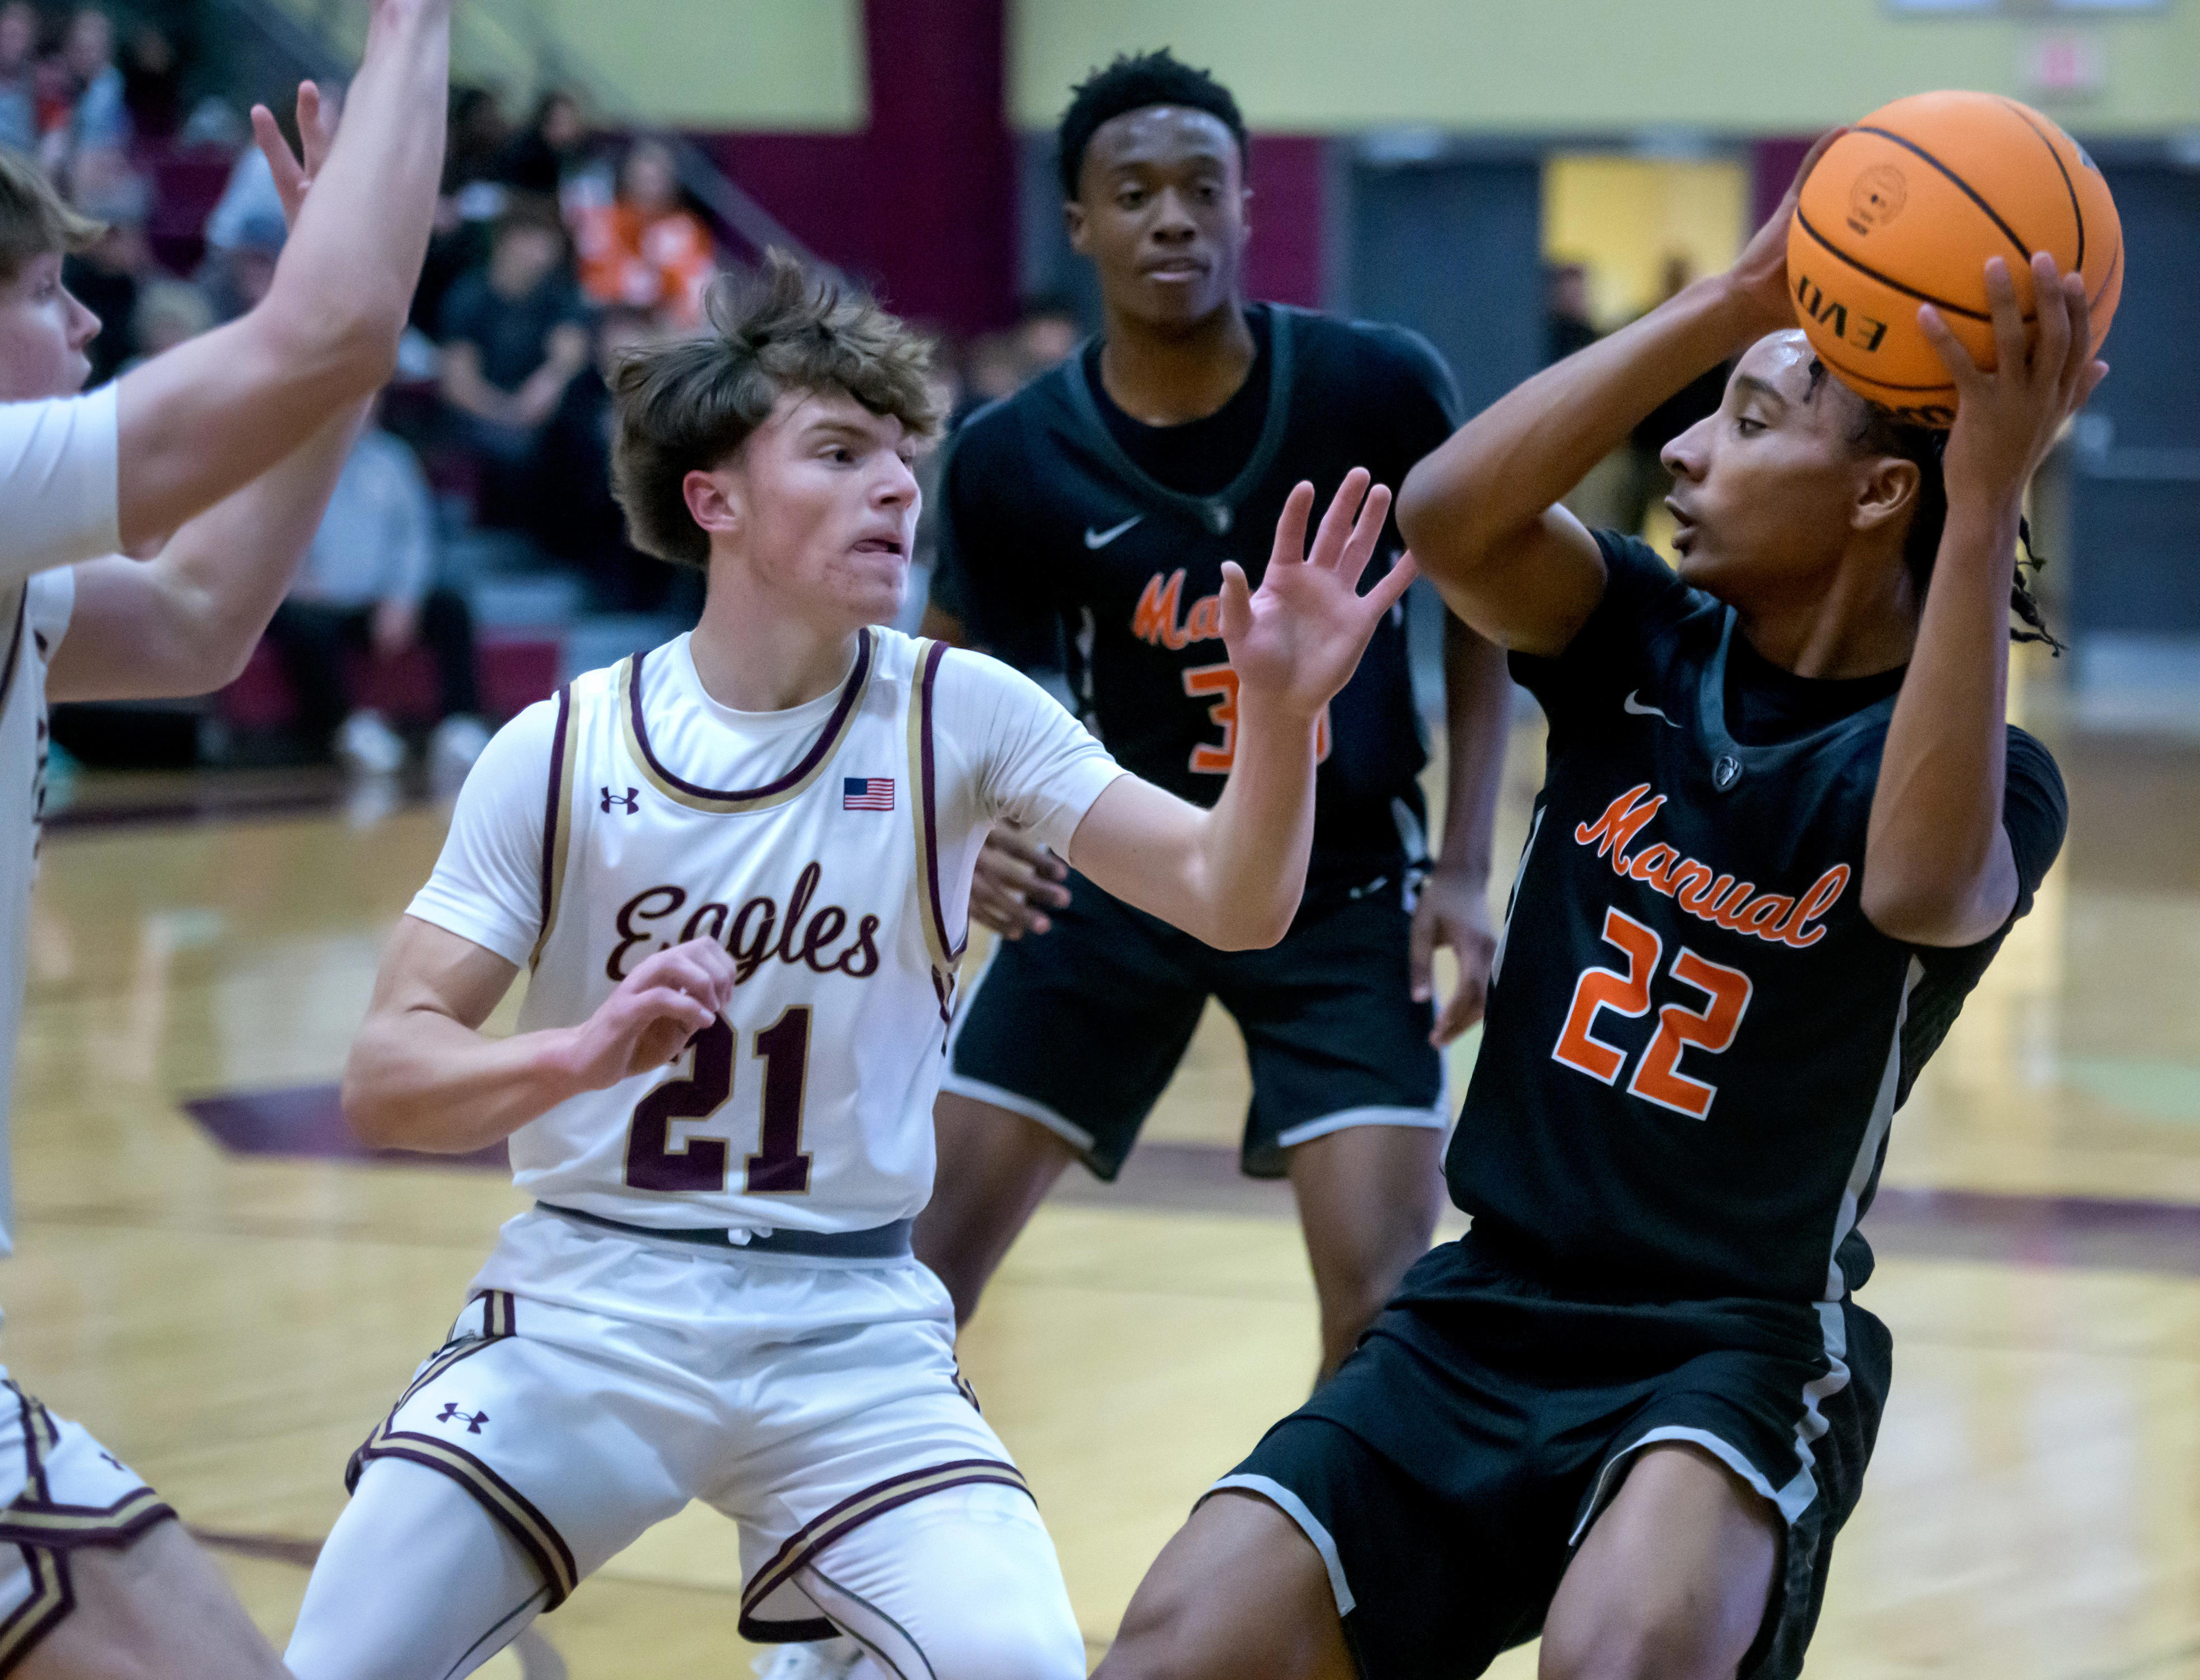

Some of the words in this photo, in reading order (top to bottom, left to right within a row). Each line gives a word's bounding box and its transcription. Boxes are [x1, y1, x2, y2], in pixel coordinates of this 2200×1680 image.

[1183, 663, 1331, 774] 3
[1575, 783, 1851, 948] Manual
[622, 1004, 814, 1195] 21
[1551, 906, 1753, 1121] 22
